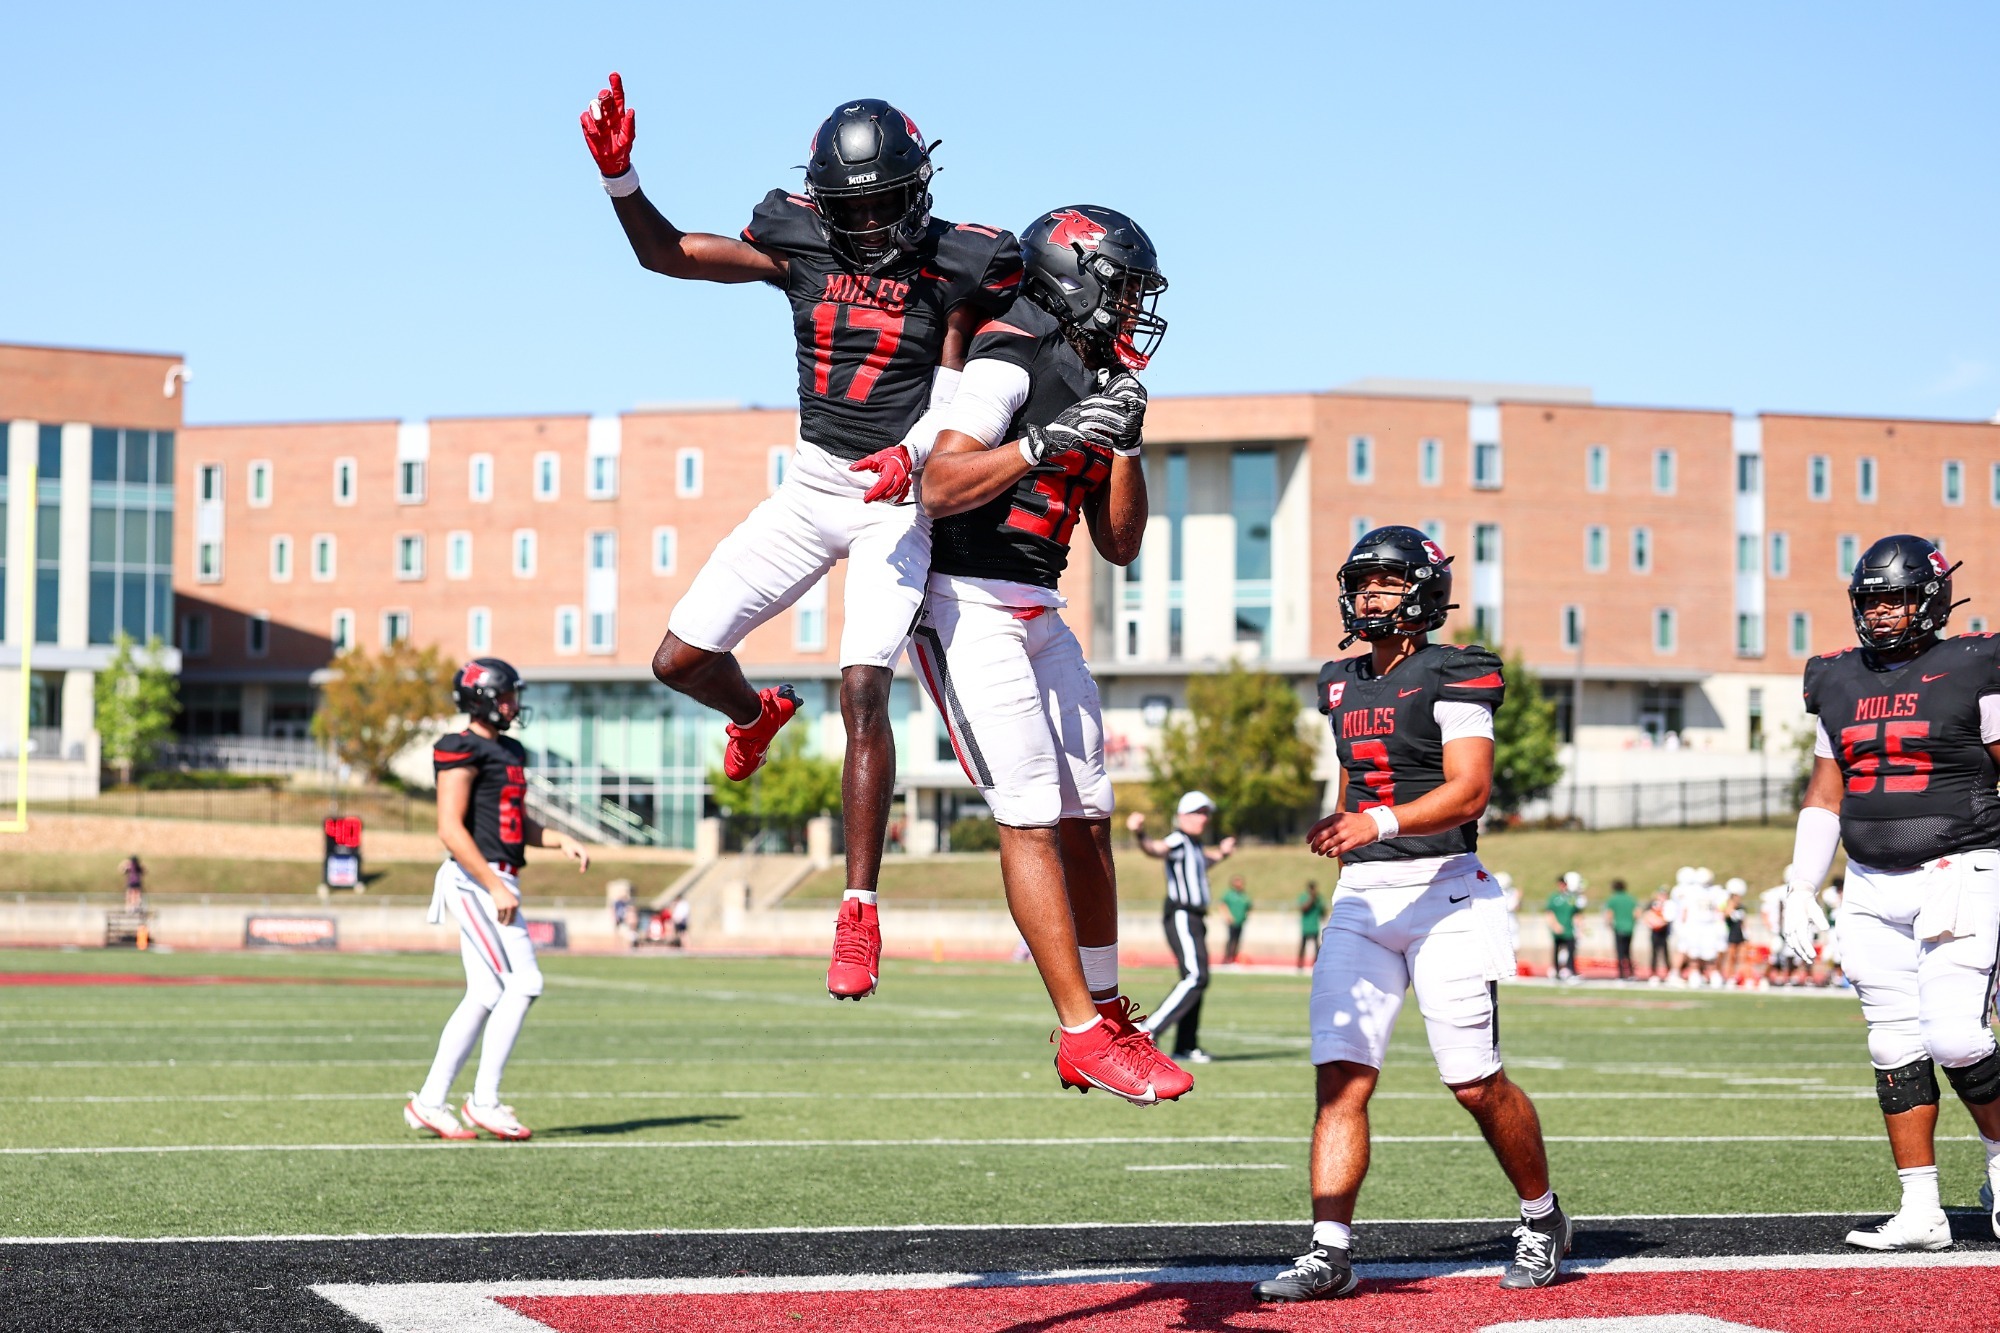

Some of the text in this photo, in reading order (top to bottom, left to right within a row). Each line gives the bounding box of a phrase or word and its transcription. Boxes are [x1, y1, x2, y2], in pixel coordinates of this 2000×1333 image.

[822, 274, 911, 312] MULES
[810, 301, 906, 404] 17
[1329, 683, 1345, 702] C
[1855, 693, 1919, 721] MULES
[1342, 707, 1395, 739] MULES
[1350, 738, 1397, 814] 3
[1841, 721, 1933, 793] 55
